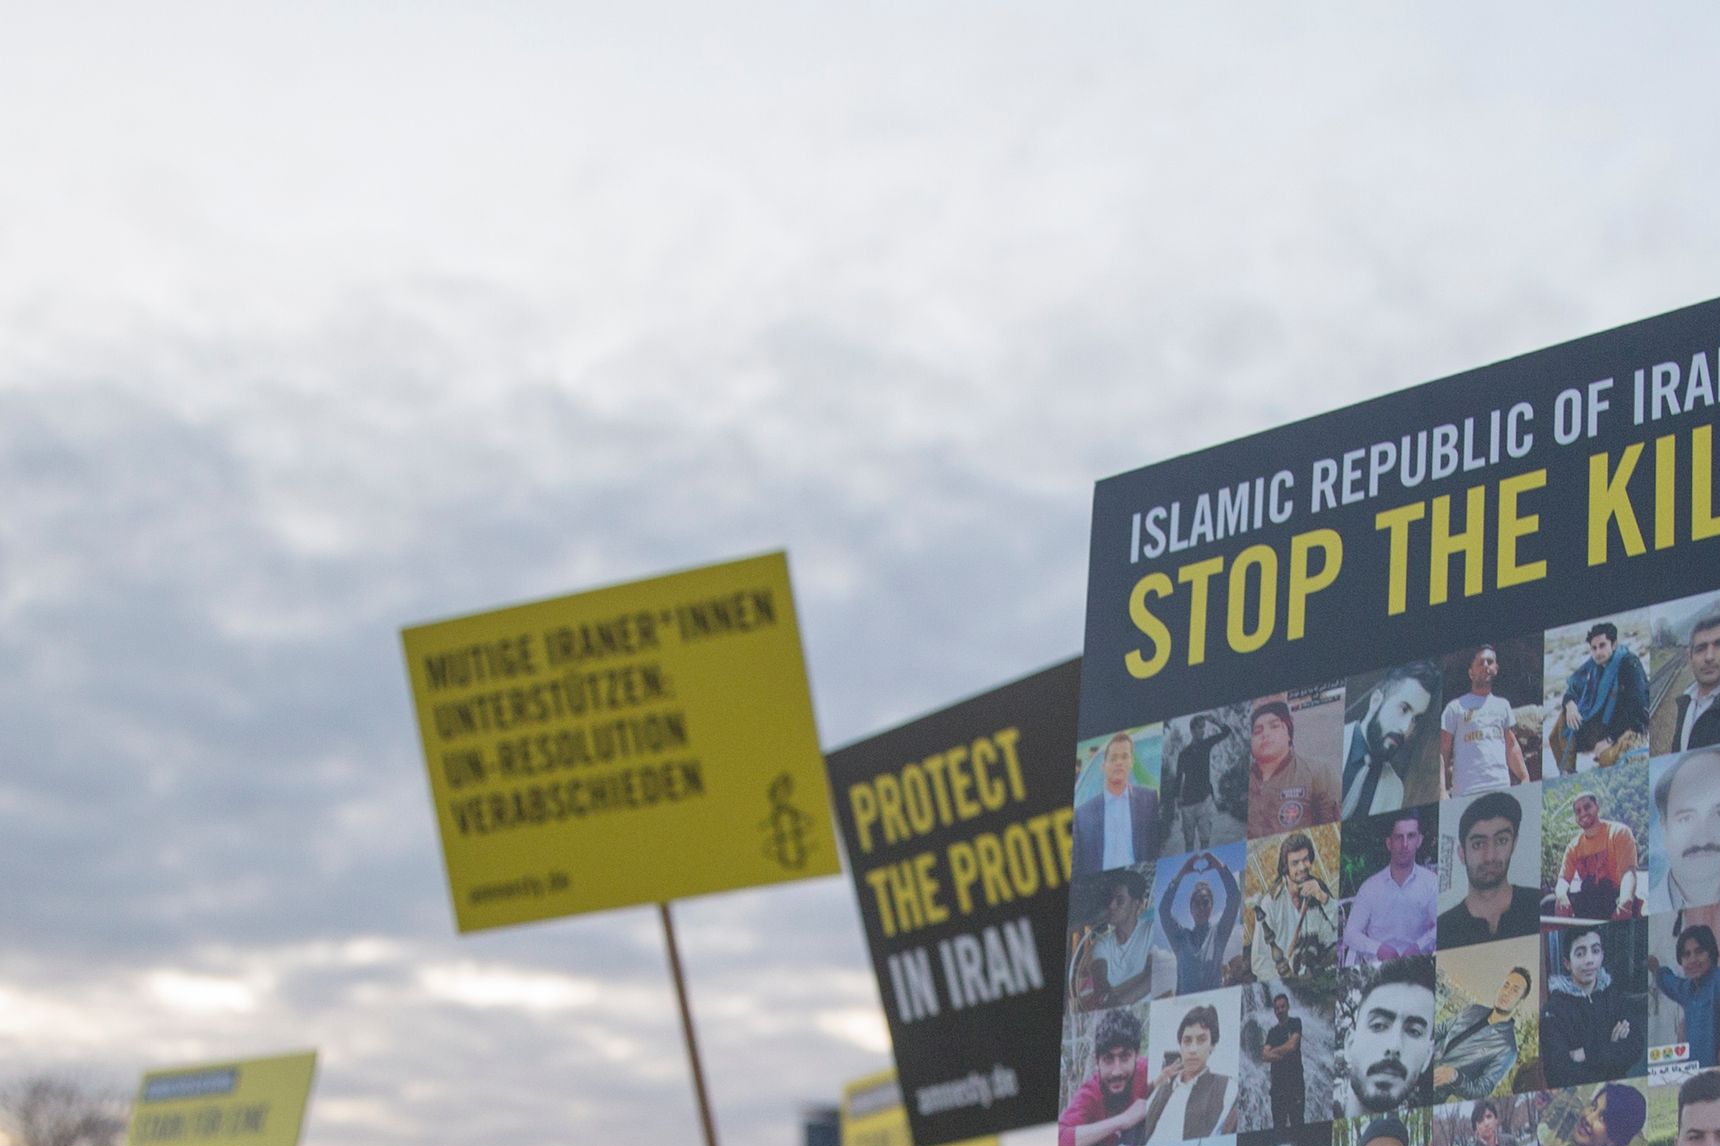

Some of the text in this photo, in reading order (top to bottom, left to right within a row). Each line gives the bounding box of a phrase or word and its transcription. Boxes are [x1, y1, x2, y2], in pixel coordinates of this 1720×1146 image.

[1129, 470, 1295, 565] ISLAMIC
[1310, 402, 1534, 514] REPUBLIC
[1553, 377, 1614, 446] OF
[1126, 530, 1342, 678] STOP
[1376, 471, 1547, 614] THE
[424, 633, 535, 690] MUTIGE
[442, 712, 688, 790] UN-RESOLUTION
[451, 760, 707, 836] VERABSCHIEDEN
[849, 726, 1026, 854] PROTECT
[865, 852, 949, 938] THE
[887, 916, 1044, 1023] IN IRAN
